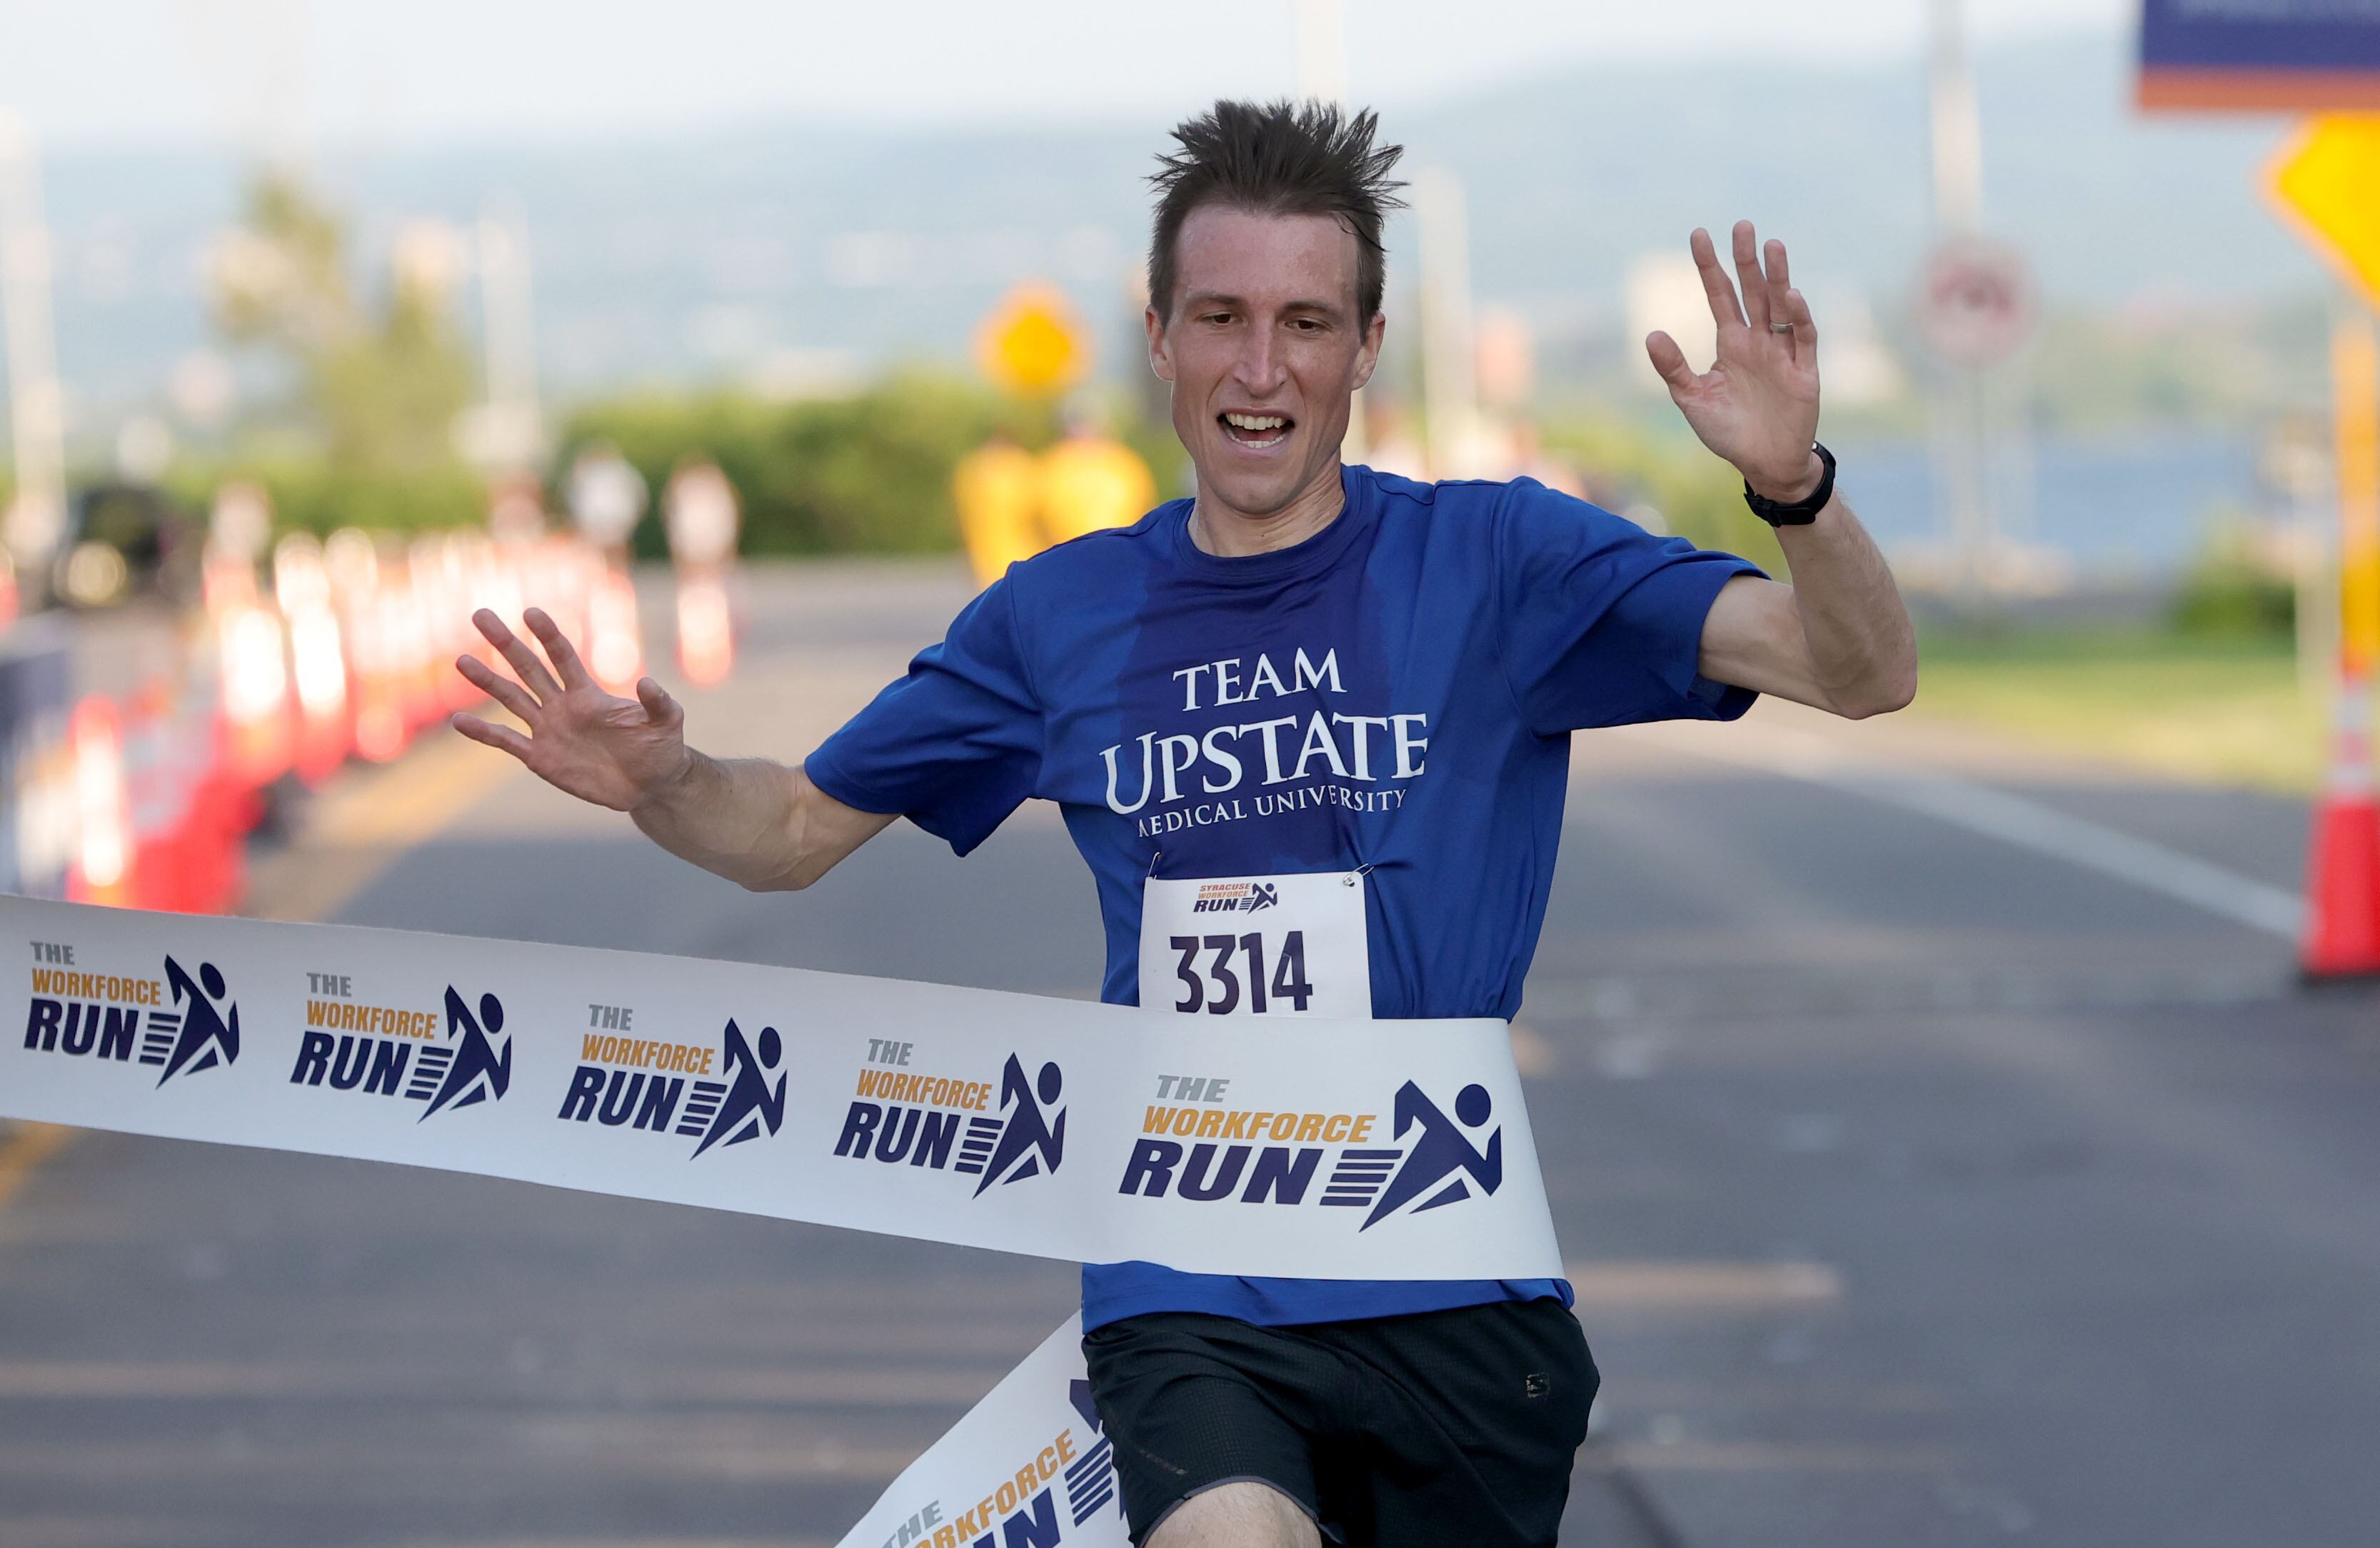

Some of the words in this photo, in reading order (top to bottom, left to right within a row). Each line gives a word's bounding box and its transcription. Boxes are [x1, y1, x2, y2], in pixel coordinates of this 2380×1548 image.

[1173, 647, 1347, 712] TEAM
[1099, 710, 1428, 815] UPSTATE
[1254, 785, 1407, 817] UNIVERSITY
[1193, 898, 1238, 913] RUN
[1198, 890, 1249, 899] WORKFORCE
[1200, 883, 1251, 892] SYRACUSE
[30, 940, 75, 965] THE
[1170, 930, 1313, 1015] 3314
[31, 968, 161, 1006] WORKFORCE
[306, 972, 352, 997] THE
[24, 997, 139, 1062] RUN
[306, 1000, 438, 1040] WORKFORCE
[588, 1004, 633, 1031] THE
[289, 1030, 411, 1098] RUN
[581, 1033, 714, 1075] WORKFORCE
[867, 1038, 913, 1067] THE
[557, 1065, 685, 1133] RUN
[856, 1069, 993, 1111] WORKFORCE
[1156, 1074, 1230, 1102] THE
[833, 1101, 961, 1170] RUN
[1143, 1105, 1377, 1143] WORKFORCE
[1118, 1138, 1324, 1205] RUN
[913, 1428, 1077, 1548] RKFORCE
